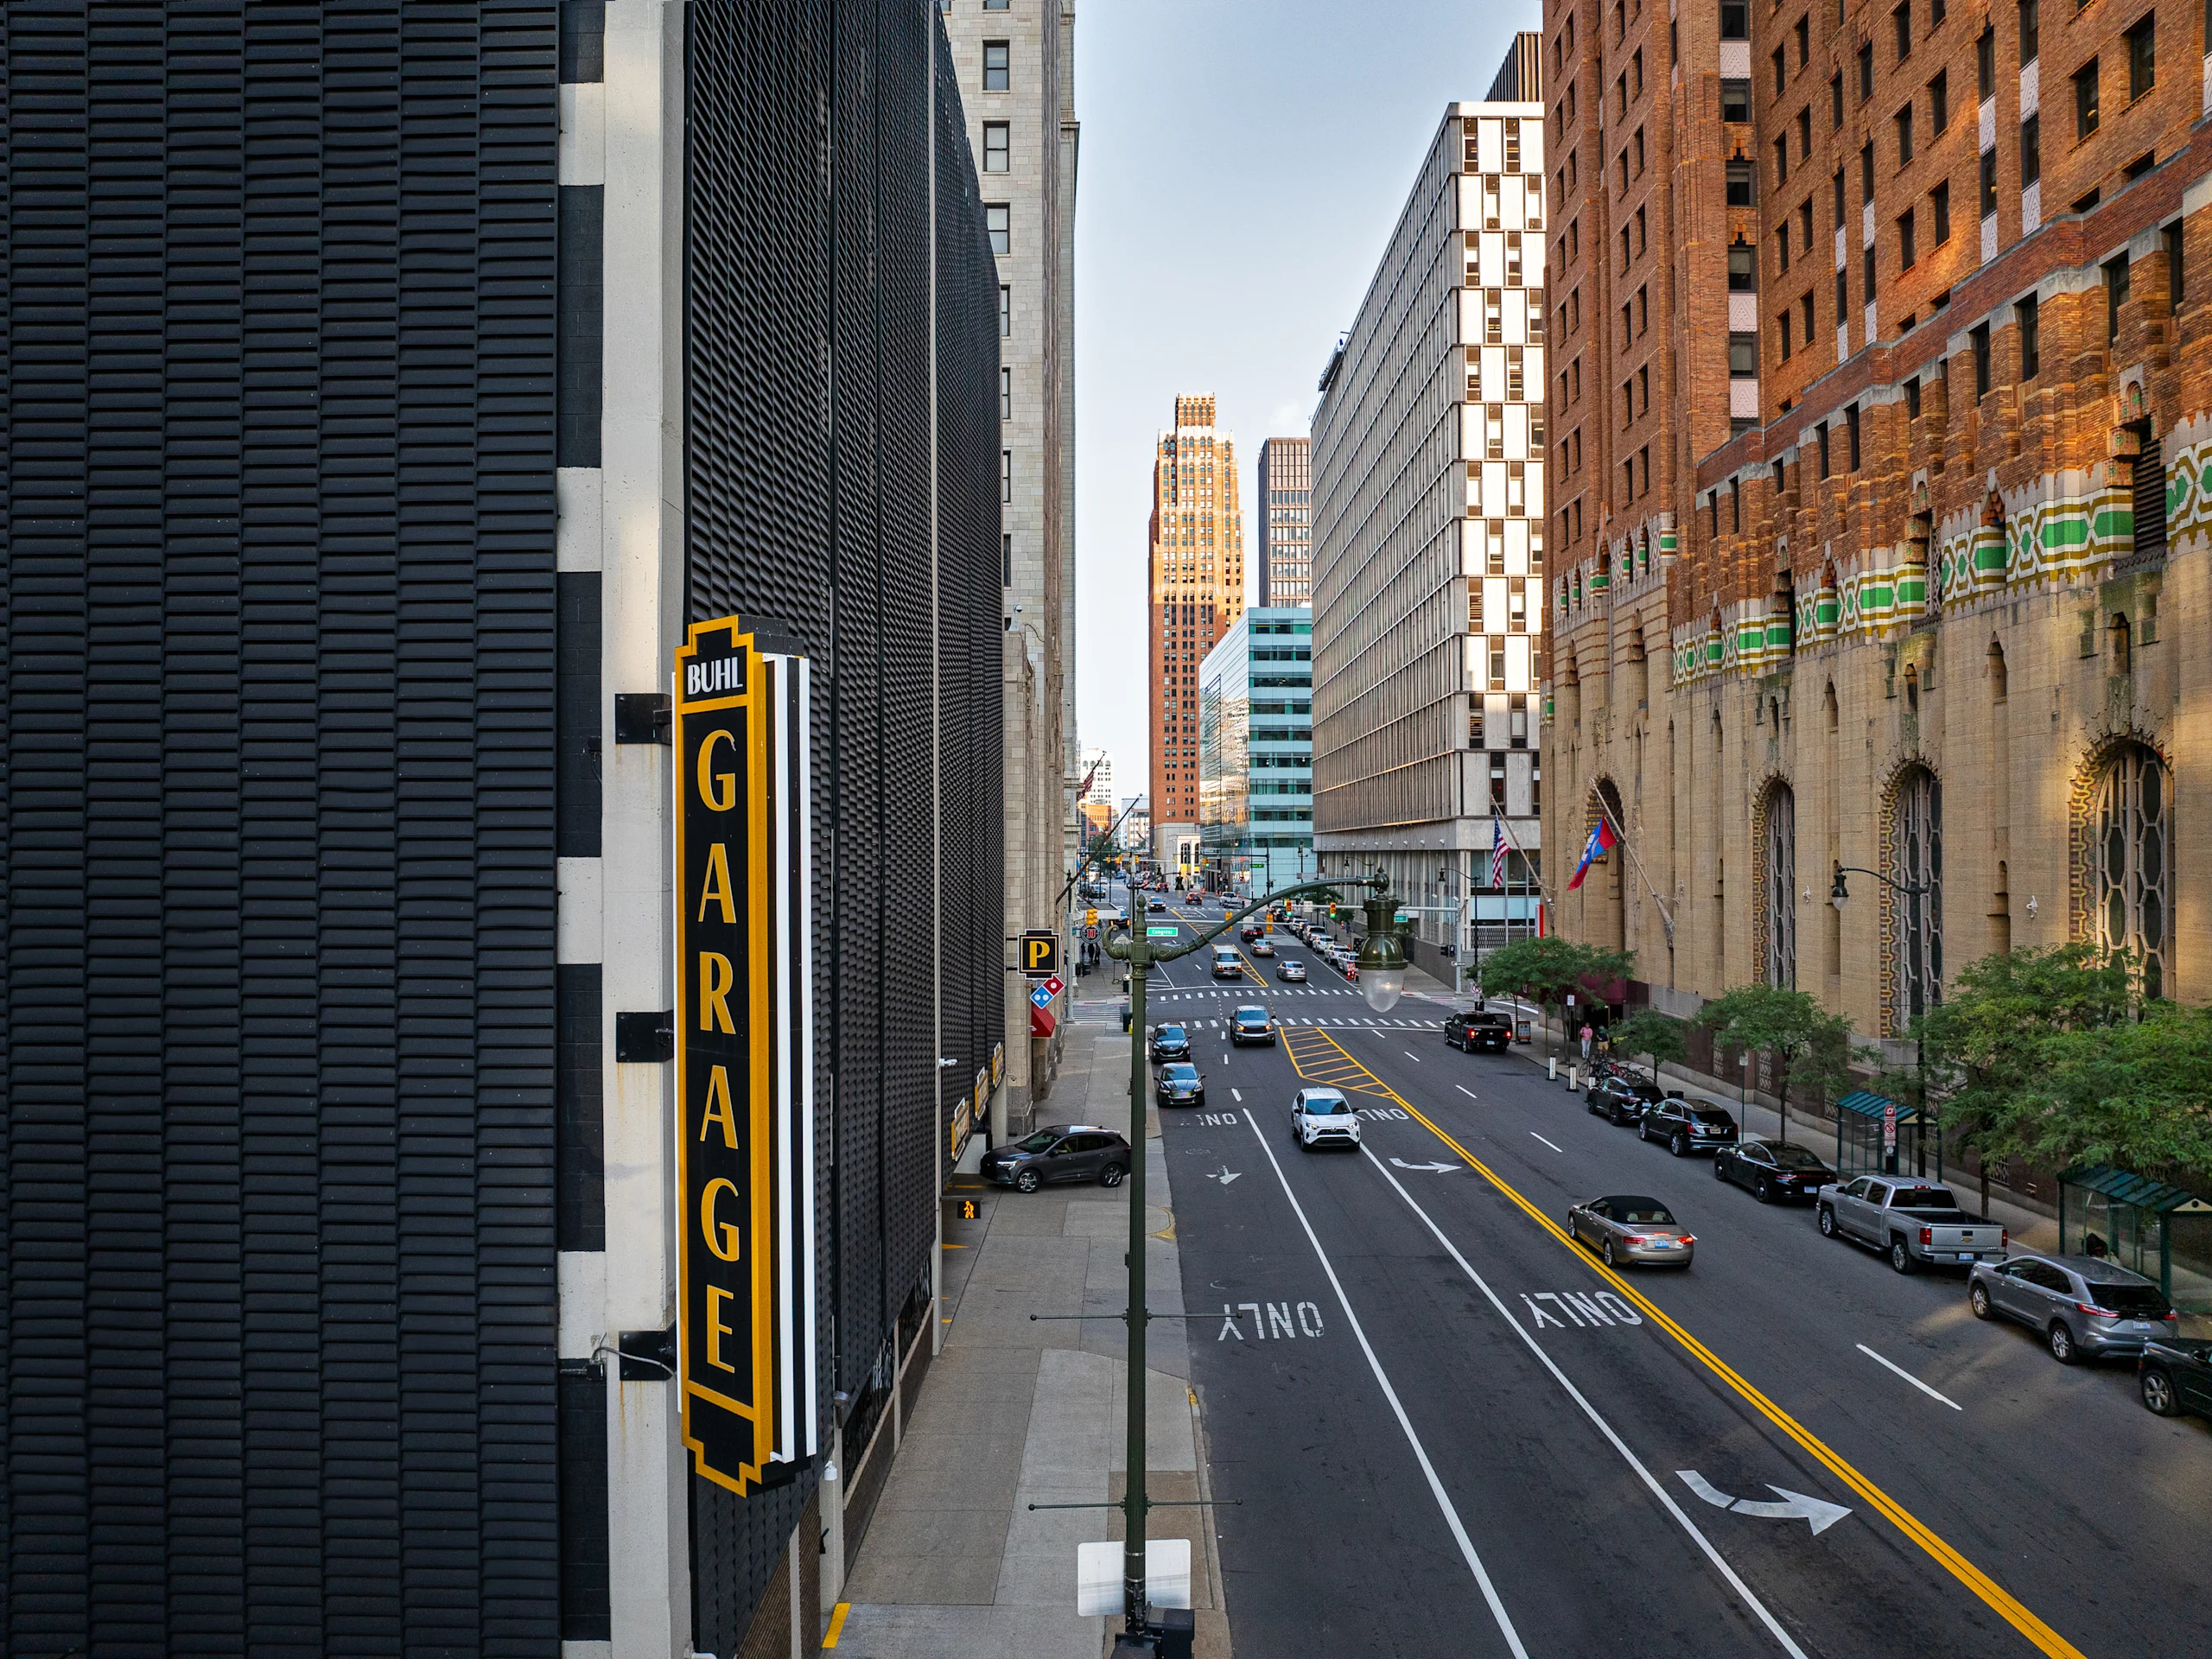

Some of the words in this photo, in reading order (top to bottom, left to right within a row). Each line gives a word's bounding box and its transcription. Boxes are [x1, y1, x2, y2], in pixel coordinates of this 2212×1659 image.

[688, 657, 743, 695] BUHL
[1029, 941, 1051, 968] P
[697, 729, 741, 1374] GARAGE
[1217, 1301, 1325, 1341] ONLY
[1519, 1291, 1643, 1329] ONLY
